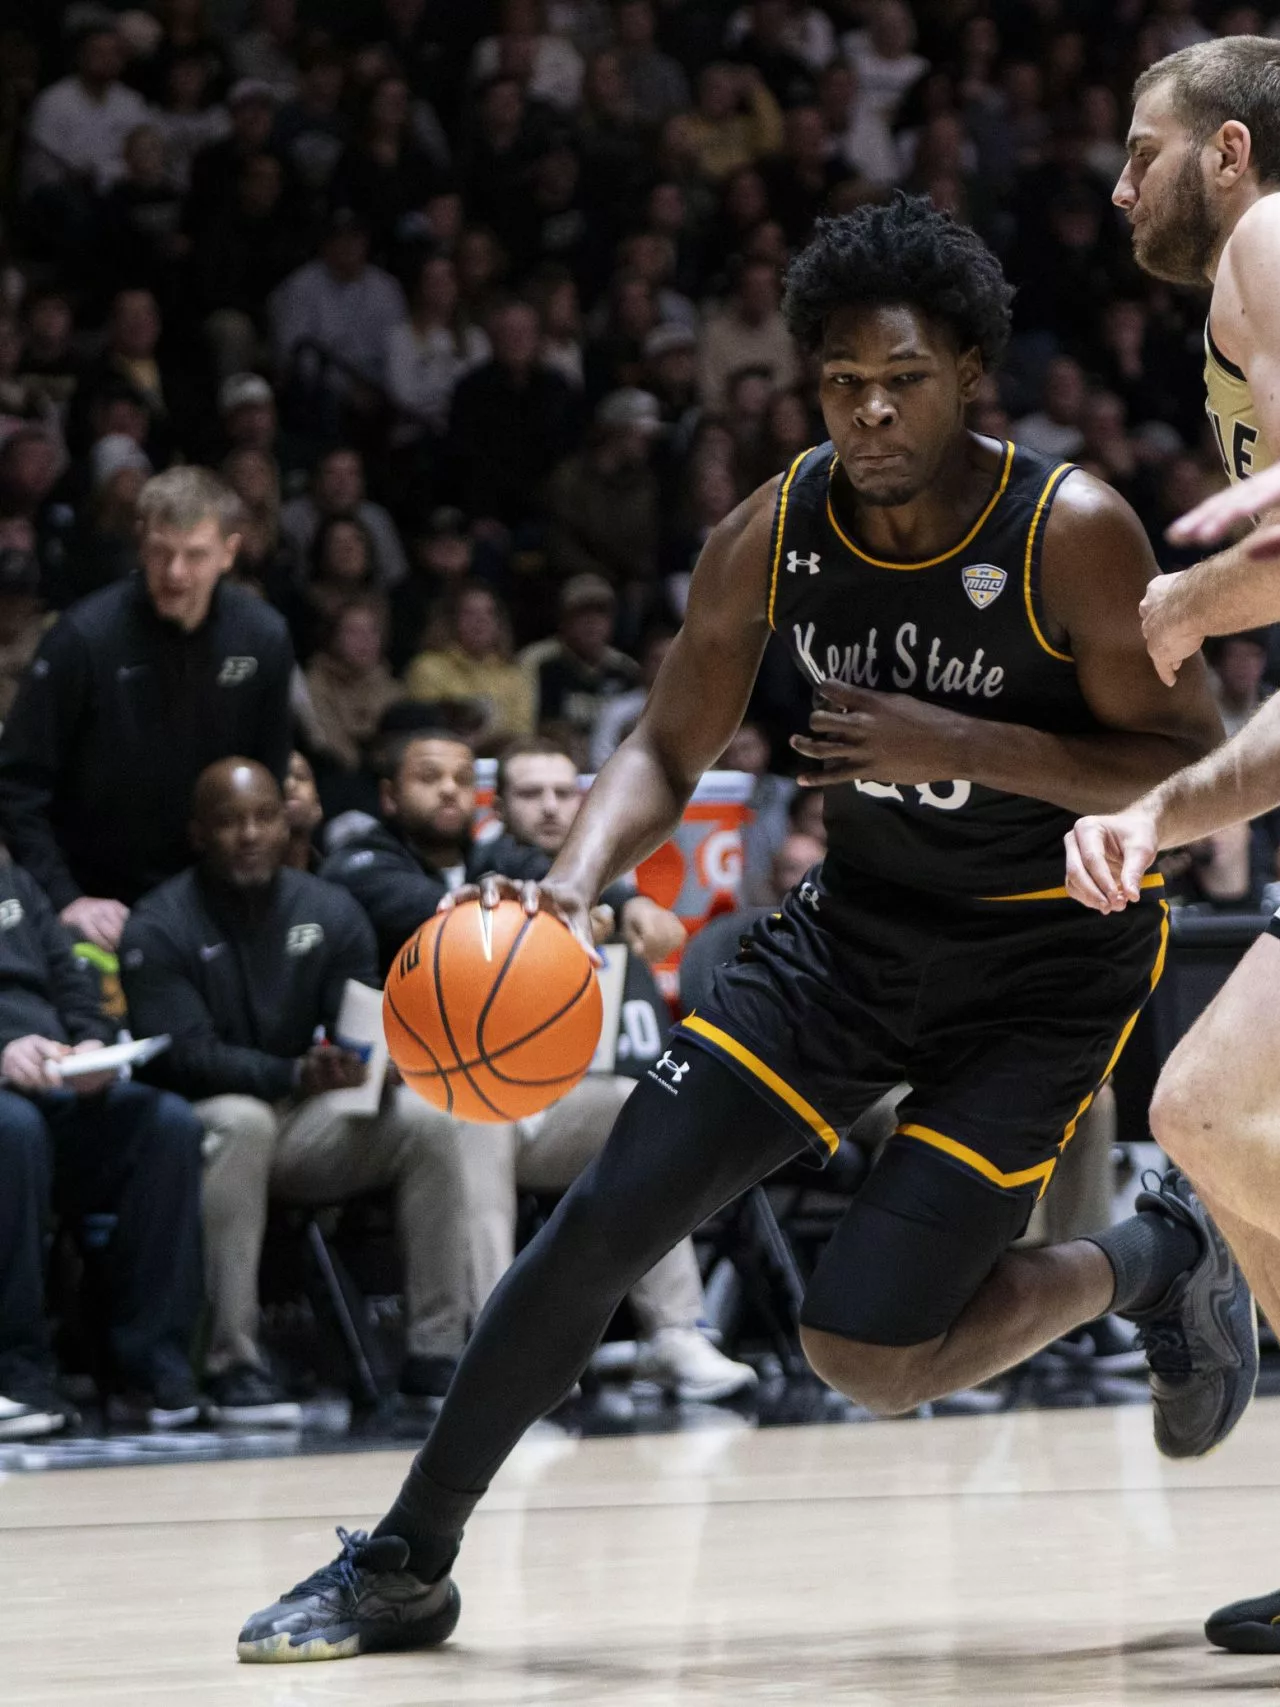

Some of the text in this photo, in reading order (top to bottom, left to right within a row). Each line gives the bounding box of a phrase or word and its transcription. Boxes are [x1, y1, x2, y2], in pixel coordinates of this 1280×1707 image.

[966, 577, 1003, 591] MAC
[793, 621, 1005, 698] Kent State
